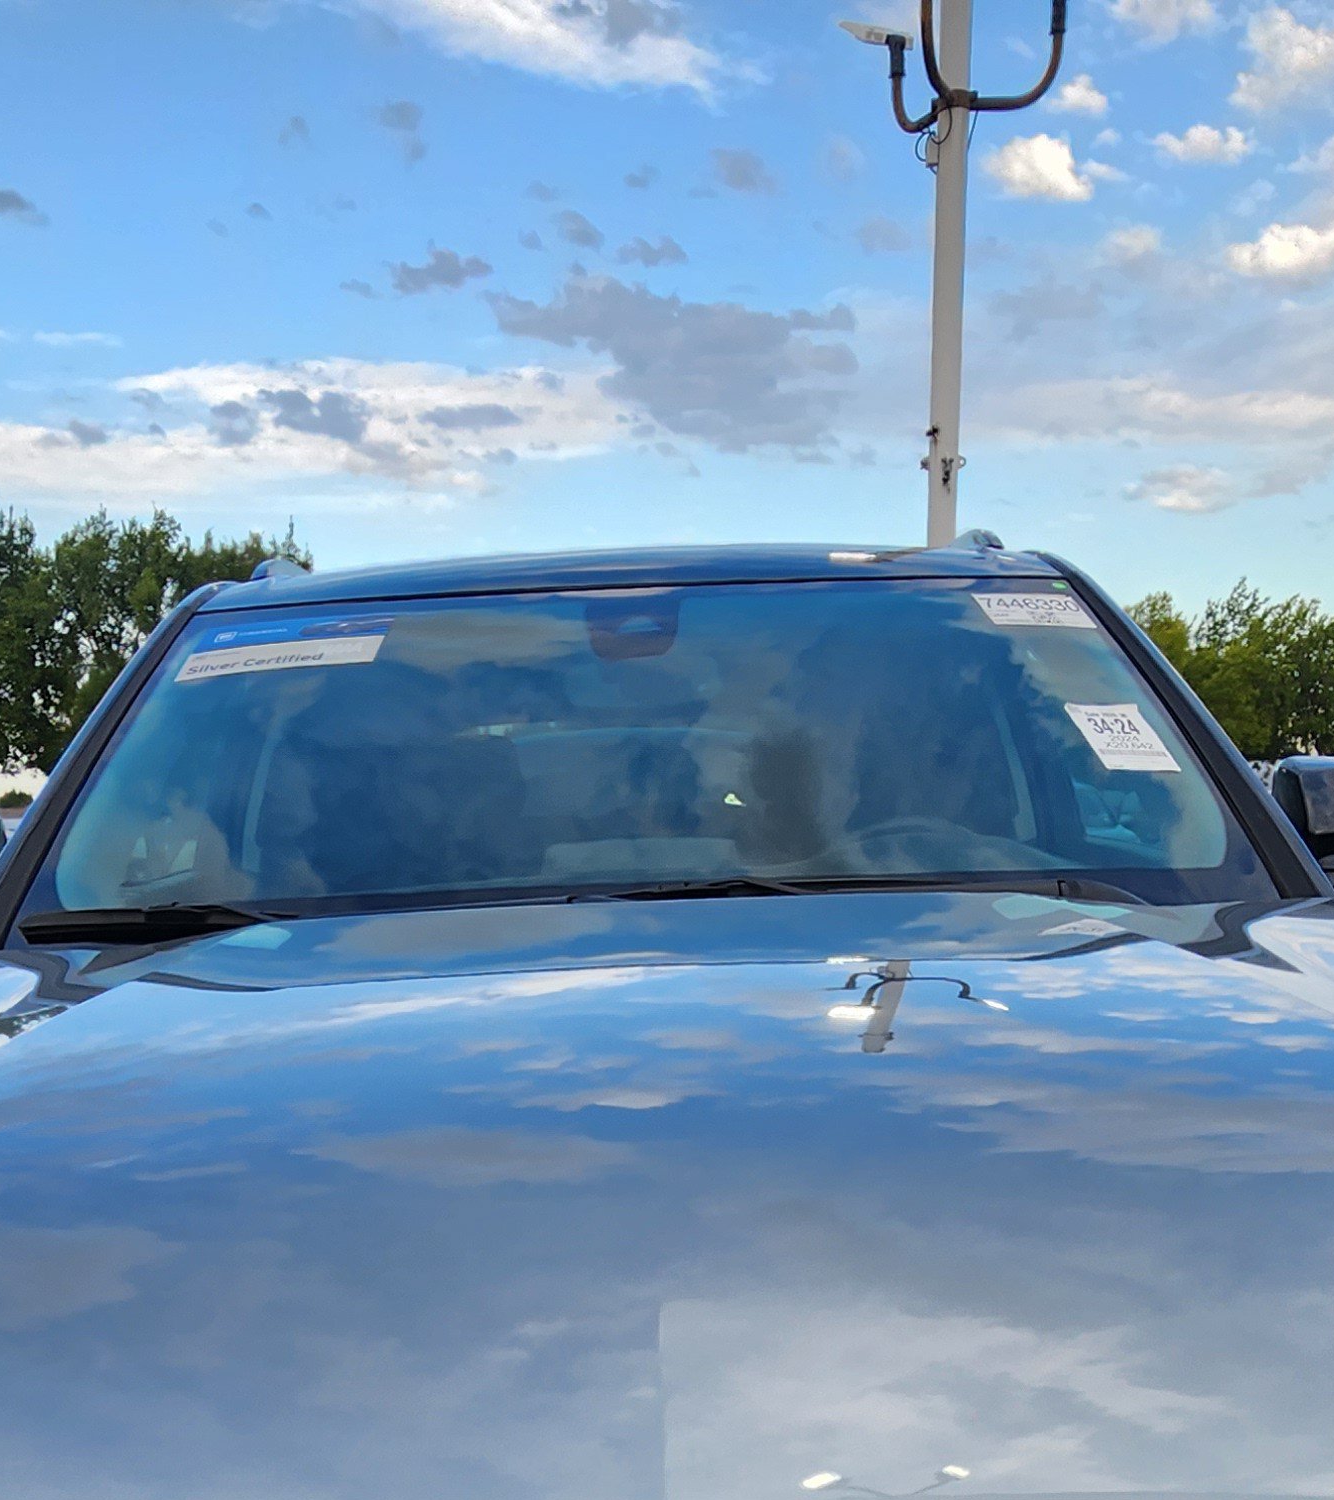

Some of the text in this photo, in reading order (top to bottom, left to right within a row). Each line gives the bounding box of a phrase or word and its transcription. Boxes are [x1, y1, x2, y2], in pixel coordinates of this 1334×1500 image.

[977, 598, 1079, 612] 7446330
[186, 661, 240, 675] Silver
[243, 652, 324, 667] Certified
[1087, 717, 1140, 734] 34:24
